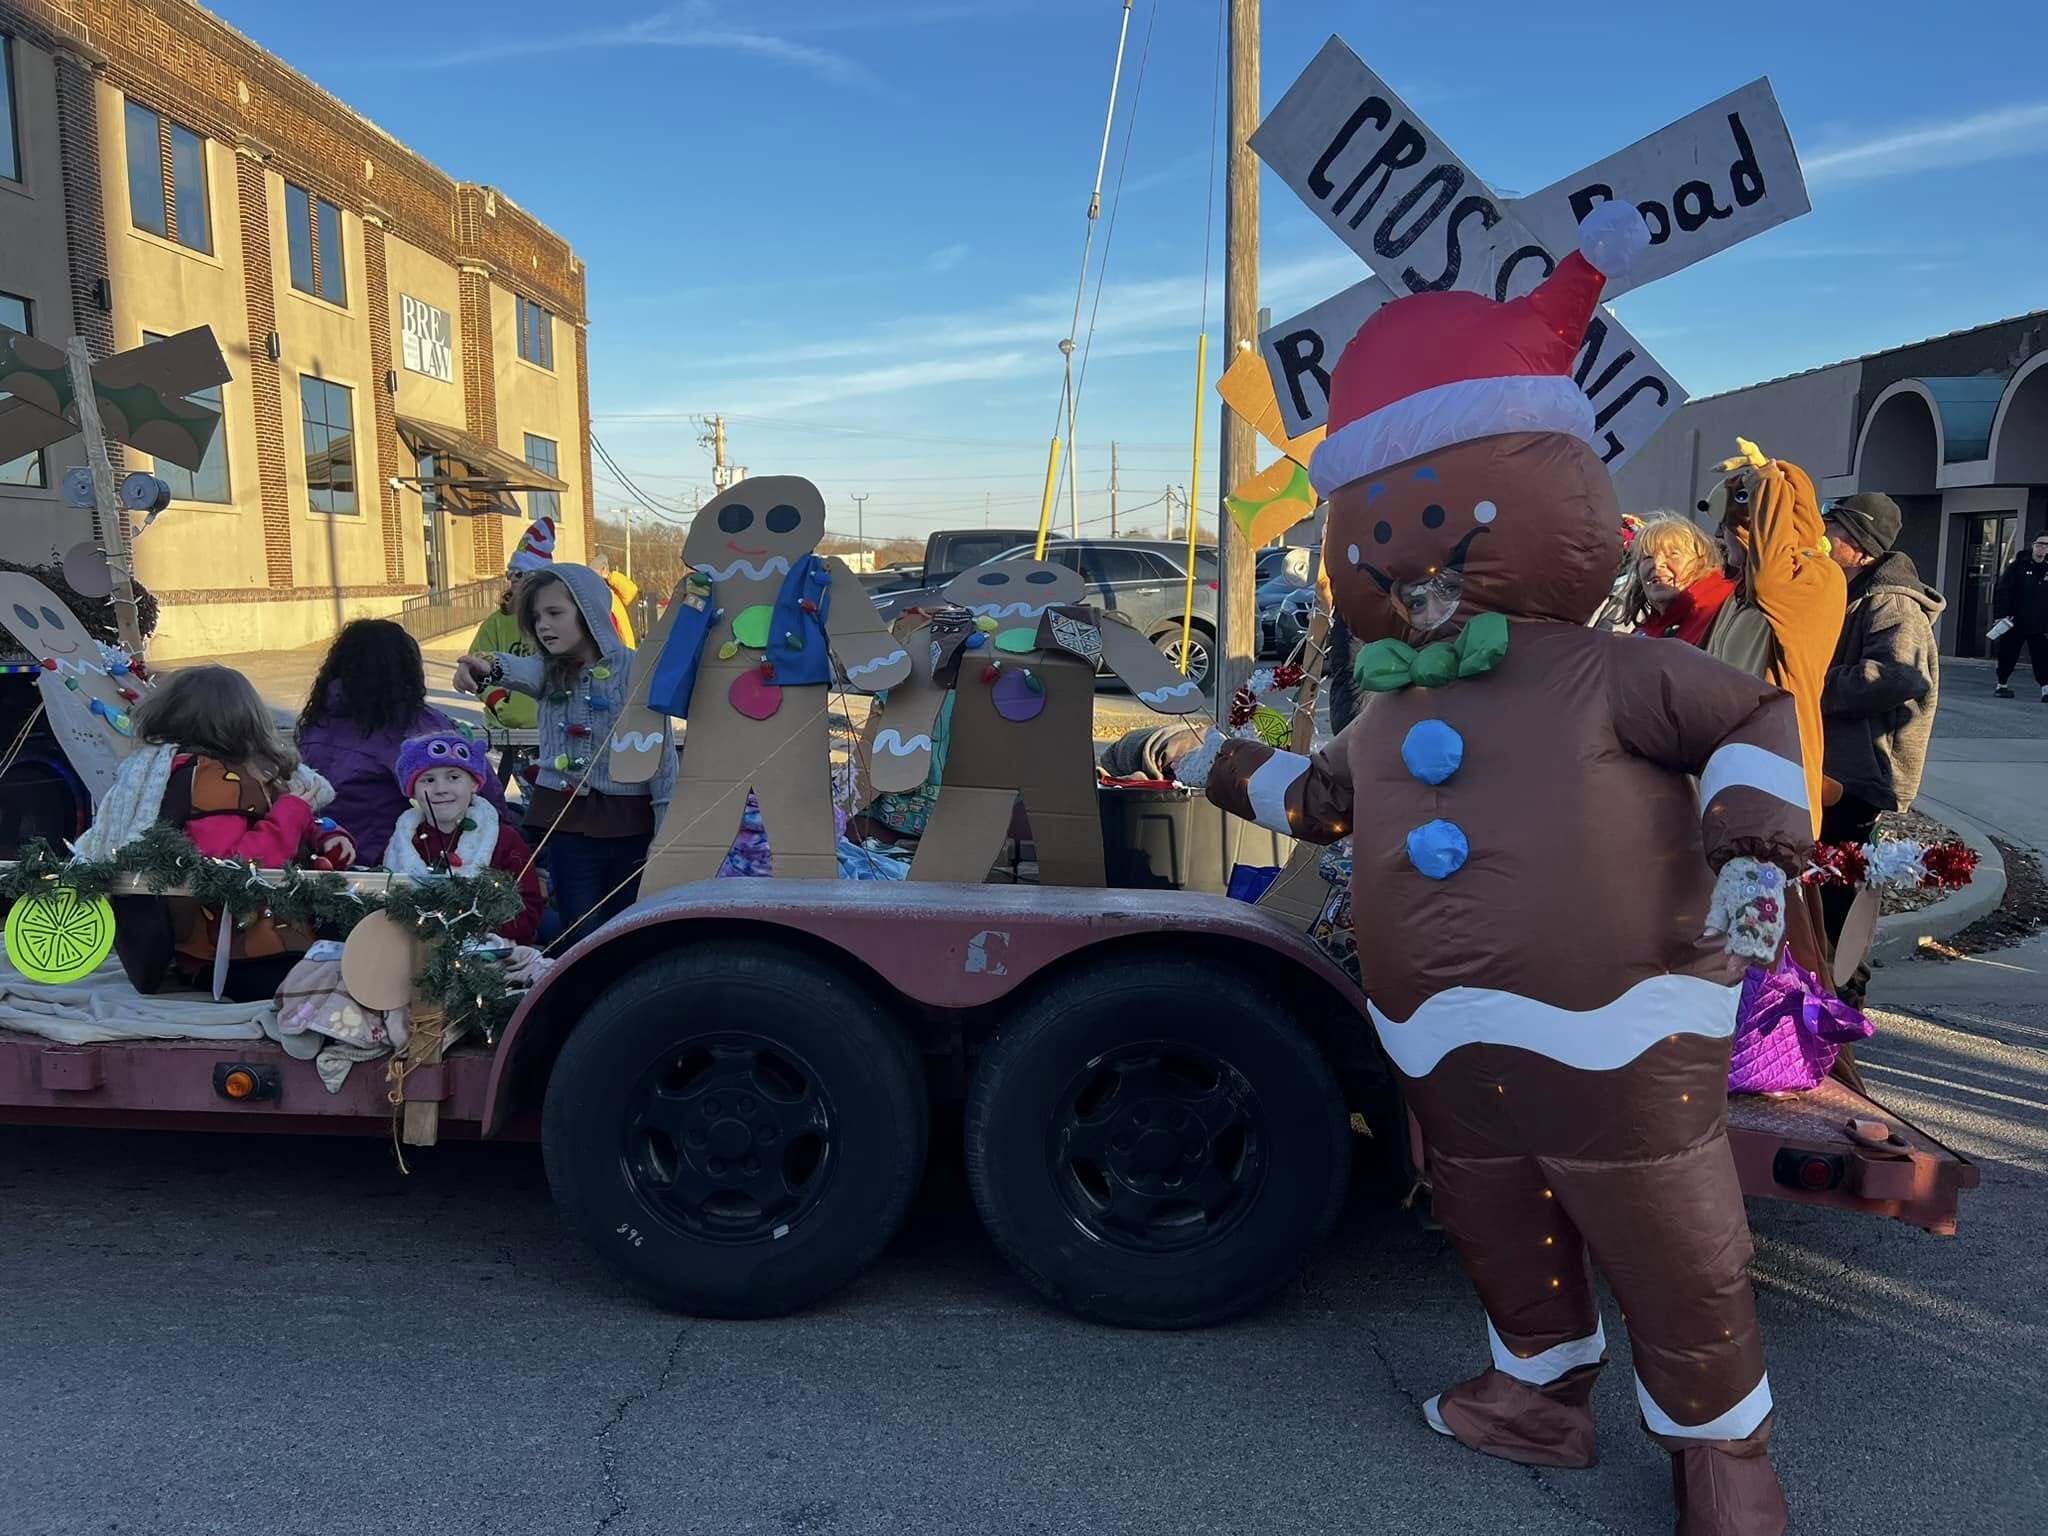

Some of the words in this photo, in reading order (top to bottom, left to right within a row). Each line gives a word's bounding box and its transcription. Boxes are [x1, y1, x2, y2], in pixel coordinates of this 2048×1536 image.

[1307, 96, 1669, 465] CROSNG
[400, 294, 445, 346] BRE
[417, 336, 451, 379] LAW
